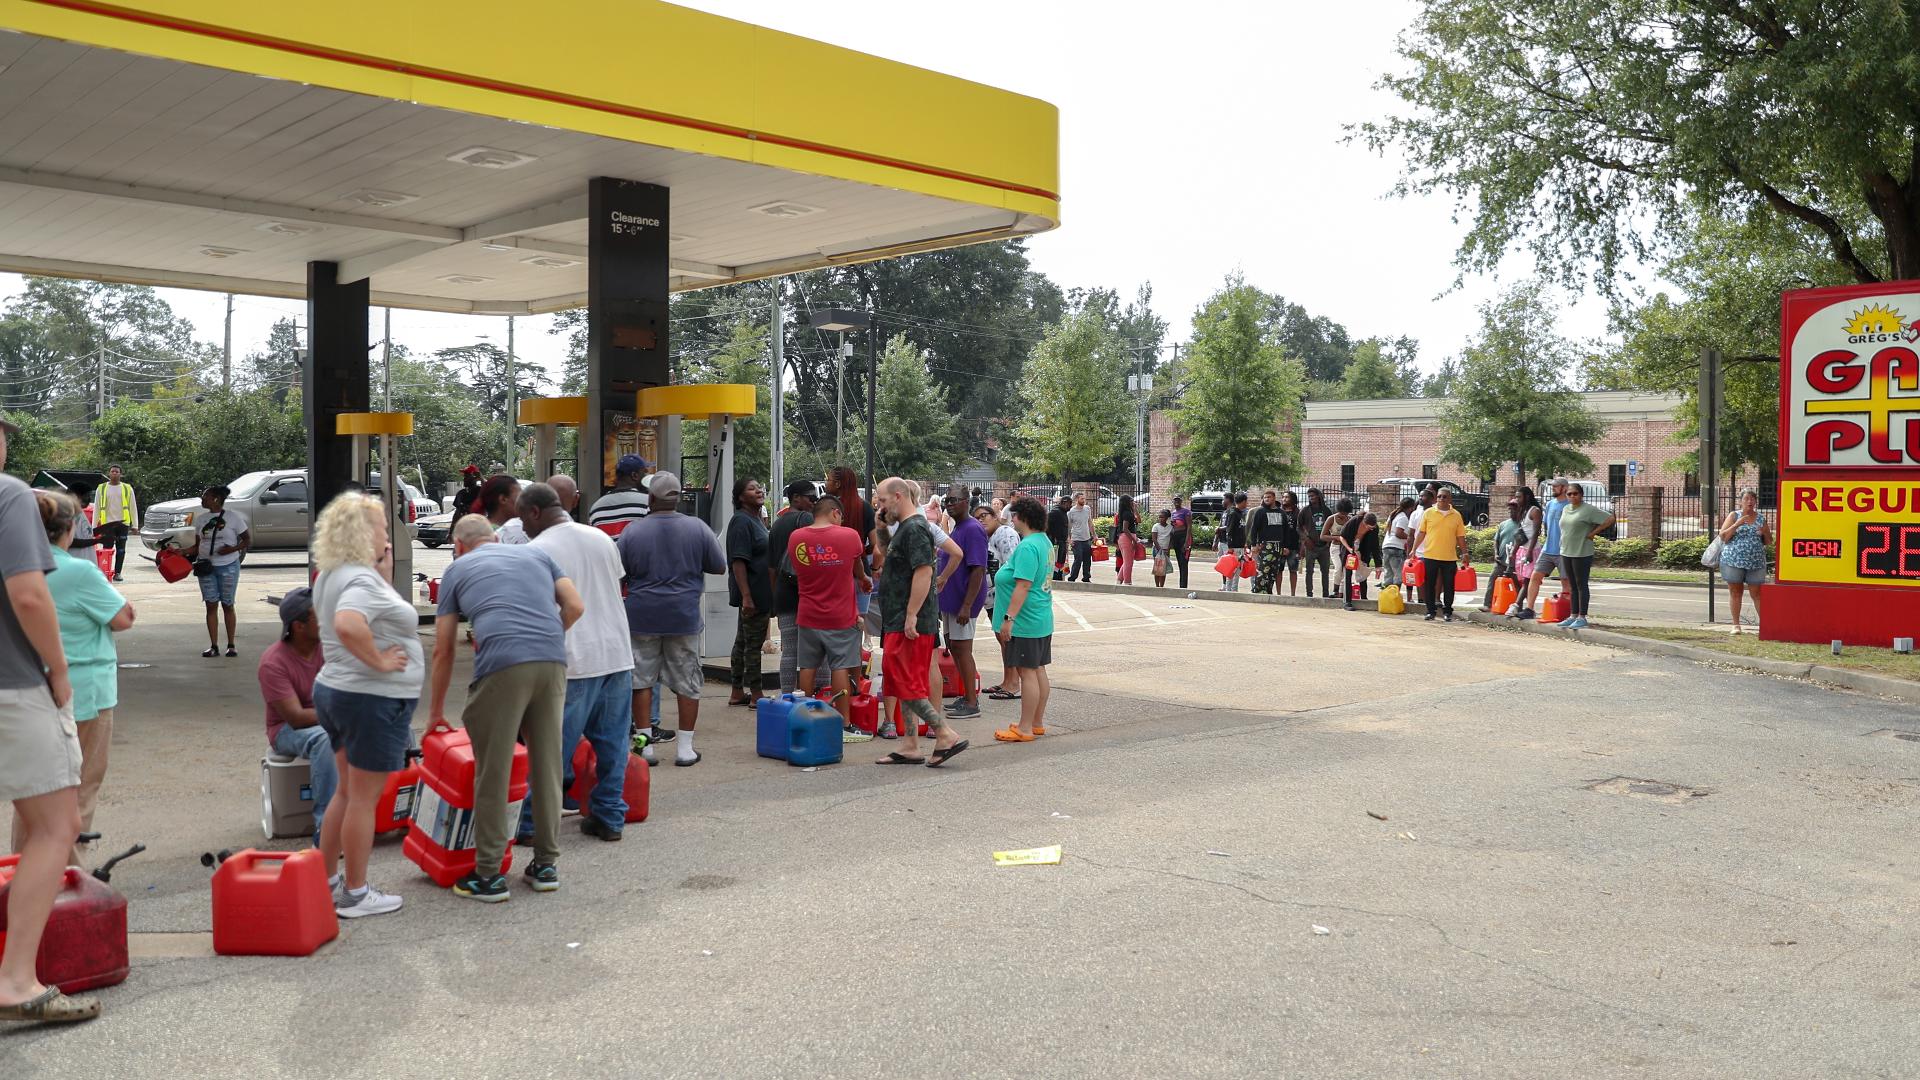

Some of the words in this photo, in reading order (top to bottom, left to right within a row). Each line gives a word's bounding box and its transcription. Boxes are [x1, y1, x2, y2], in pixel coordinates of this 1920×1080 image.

[611, 211, 660, 227] Clearance
[1848, 333, 1900, 344] GREG'S
[712, 444, 718, 457] 5
[1794, 541, 1839, 556] CASH
[810, 552, 839, 561] TACO
